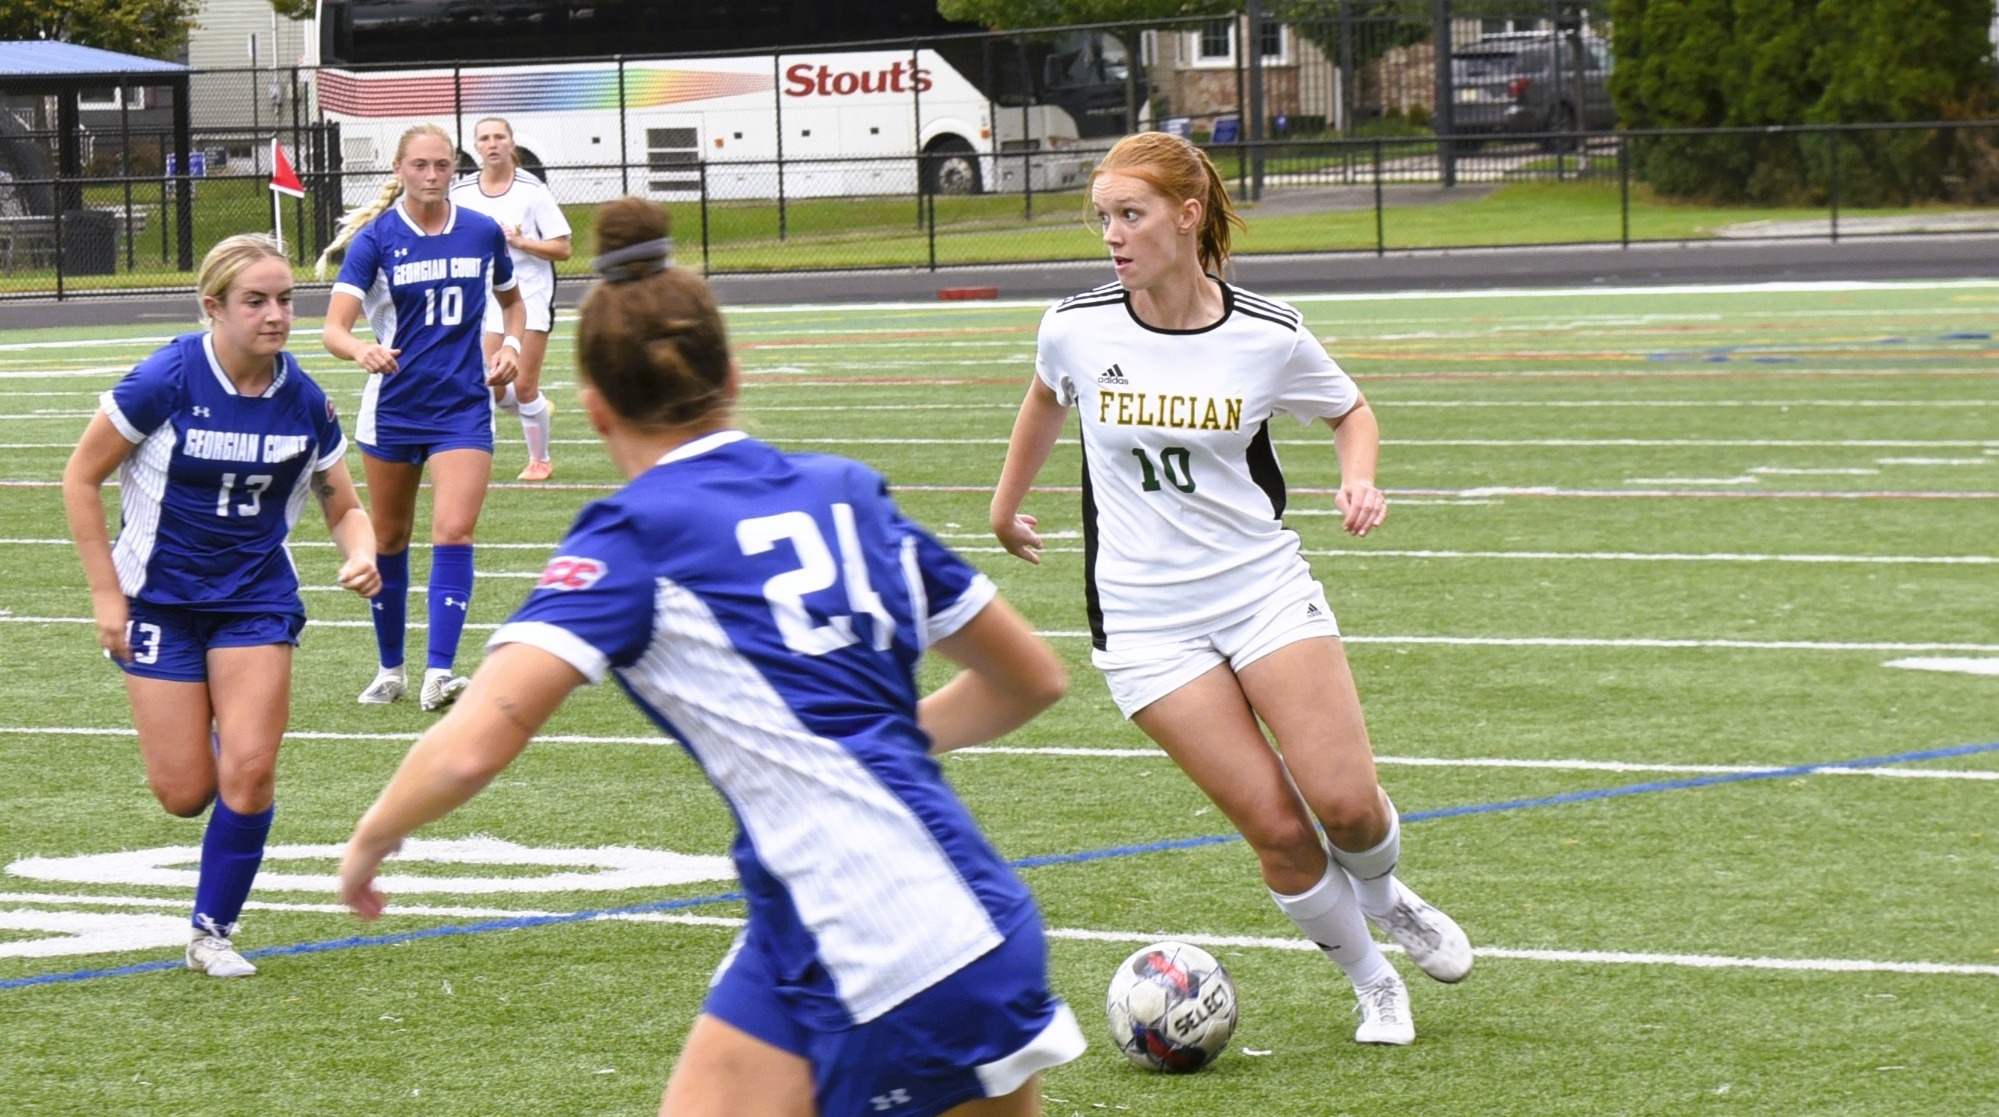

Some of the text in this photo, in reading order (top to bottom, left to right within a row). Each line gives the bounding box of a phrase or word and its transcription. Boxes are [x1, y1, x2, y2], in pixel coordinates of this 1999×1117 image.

[784, 58, 933, 97] Stout's
[393, 258, 447, 286] GEORGIAN
[425, 286, 463, 326] 10
[1097, 376, 1129, 385] adidas
[1099, 390, 1243, 431] FELICIAN
[183, 428, 309, 464] GEORGIAN COURT
[1131, 447, 1196, 493] 10
[216, 472, 273, 517] 13
[1174, 983, 1229, 1038] SELECT
